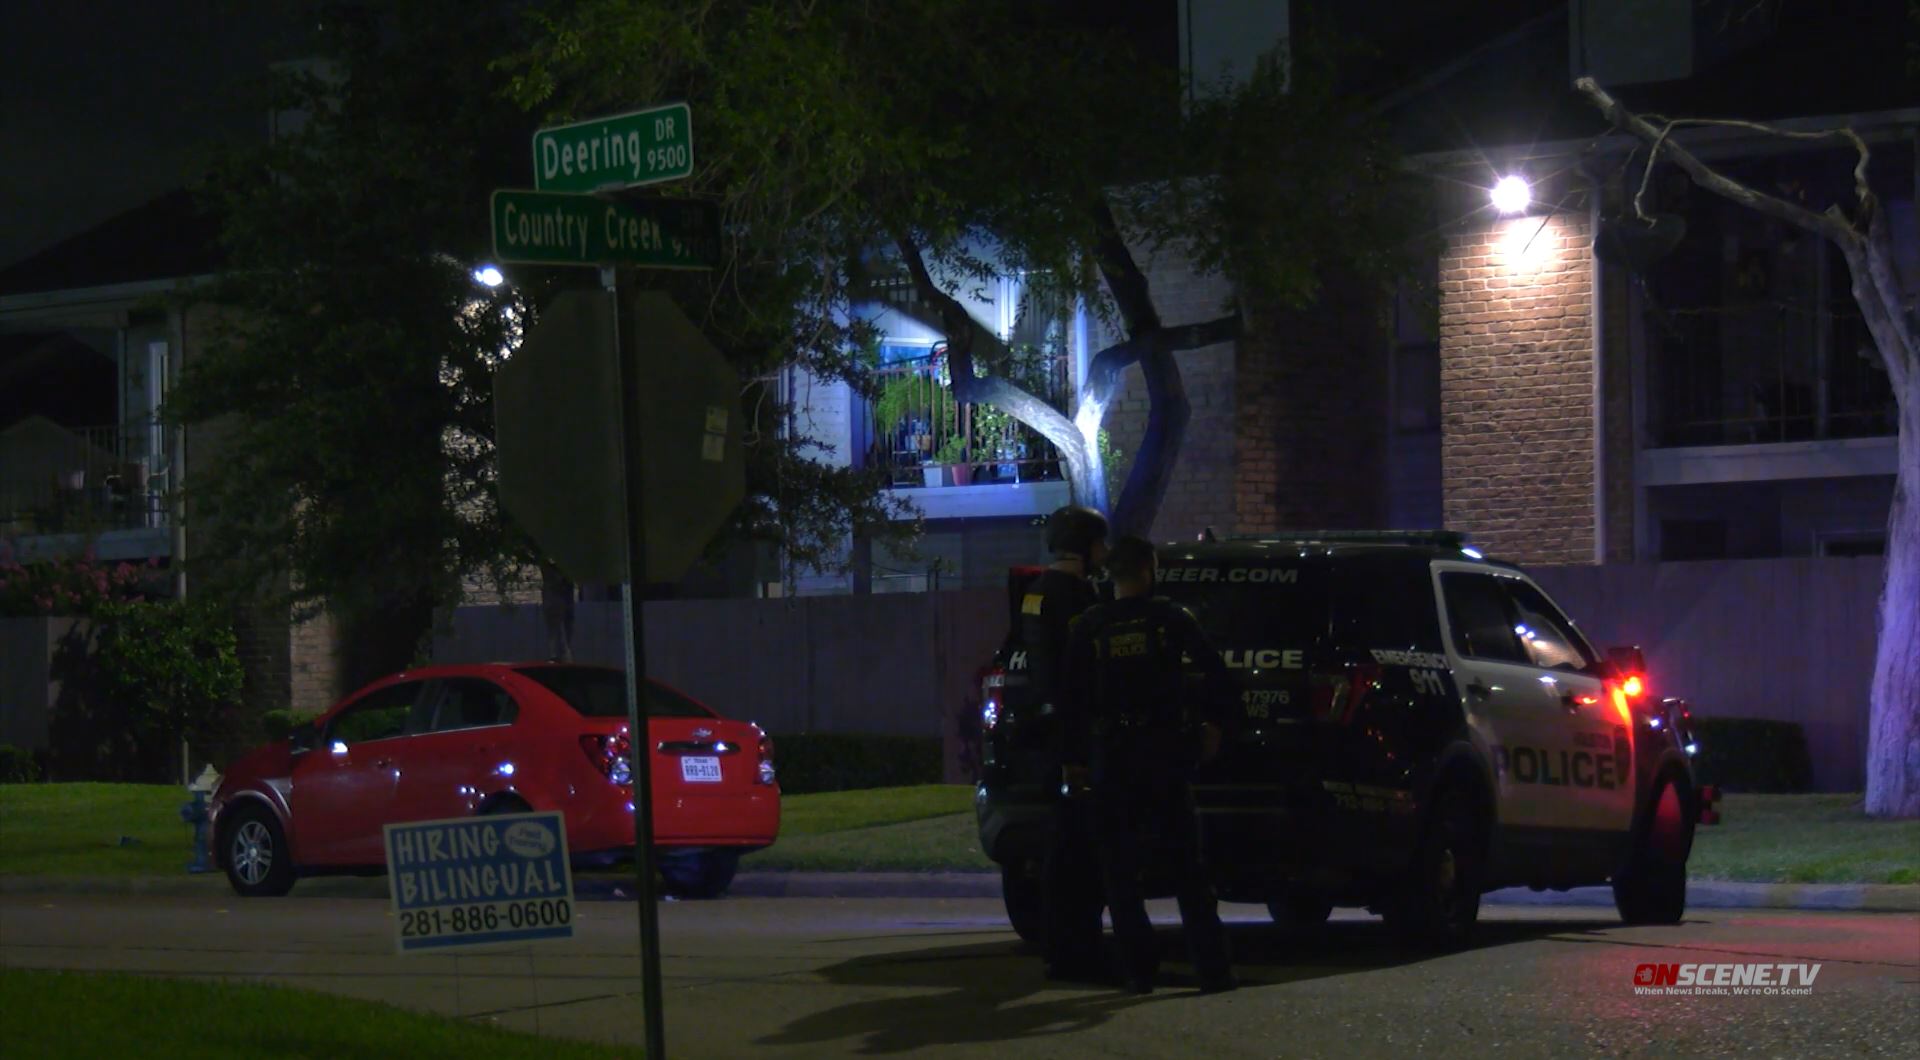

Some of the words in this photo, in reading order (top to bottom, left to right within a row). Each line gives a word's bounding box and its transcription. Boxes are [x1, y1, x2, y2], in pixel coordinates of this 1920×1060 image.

[655, 117, 675, 141] DR
[542, 127, 641, 179] Deering
[647, 145, 686, 171] 9500
[505, 202, 588, 258] Country
[1153, 568, 1299, 584] REER.COM
[1180, 650, 1304, 669] LICE
[1409, 668, 1446, 695] 911
[1490, 744, 1617, 790] POLICE
[396, 824, 500, 865] HIRING
[401, 860, 562, 904] BILINGUAL
[401, 899, 571, 937] 281-886-0600
